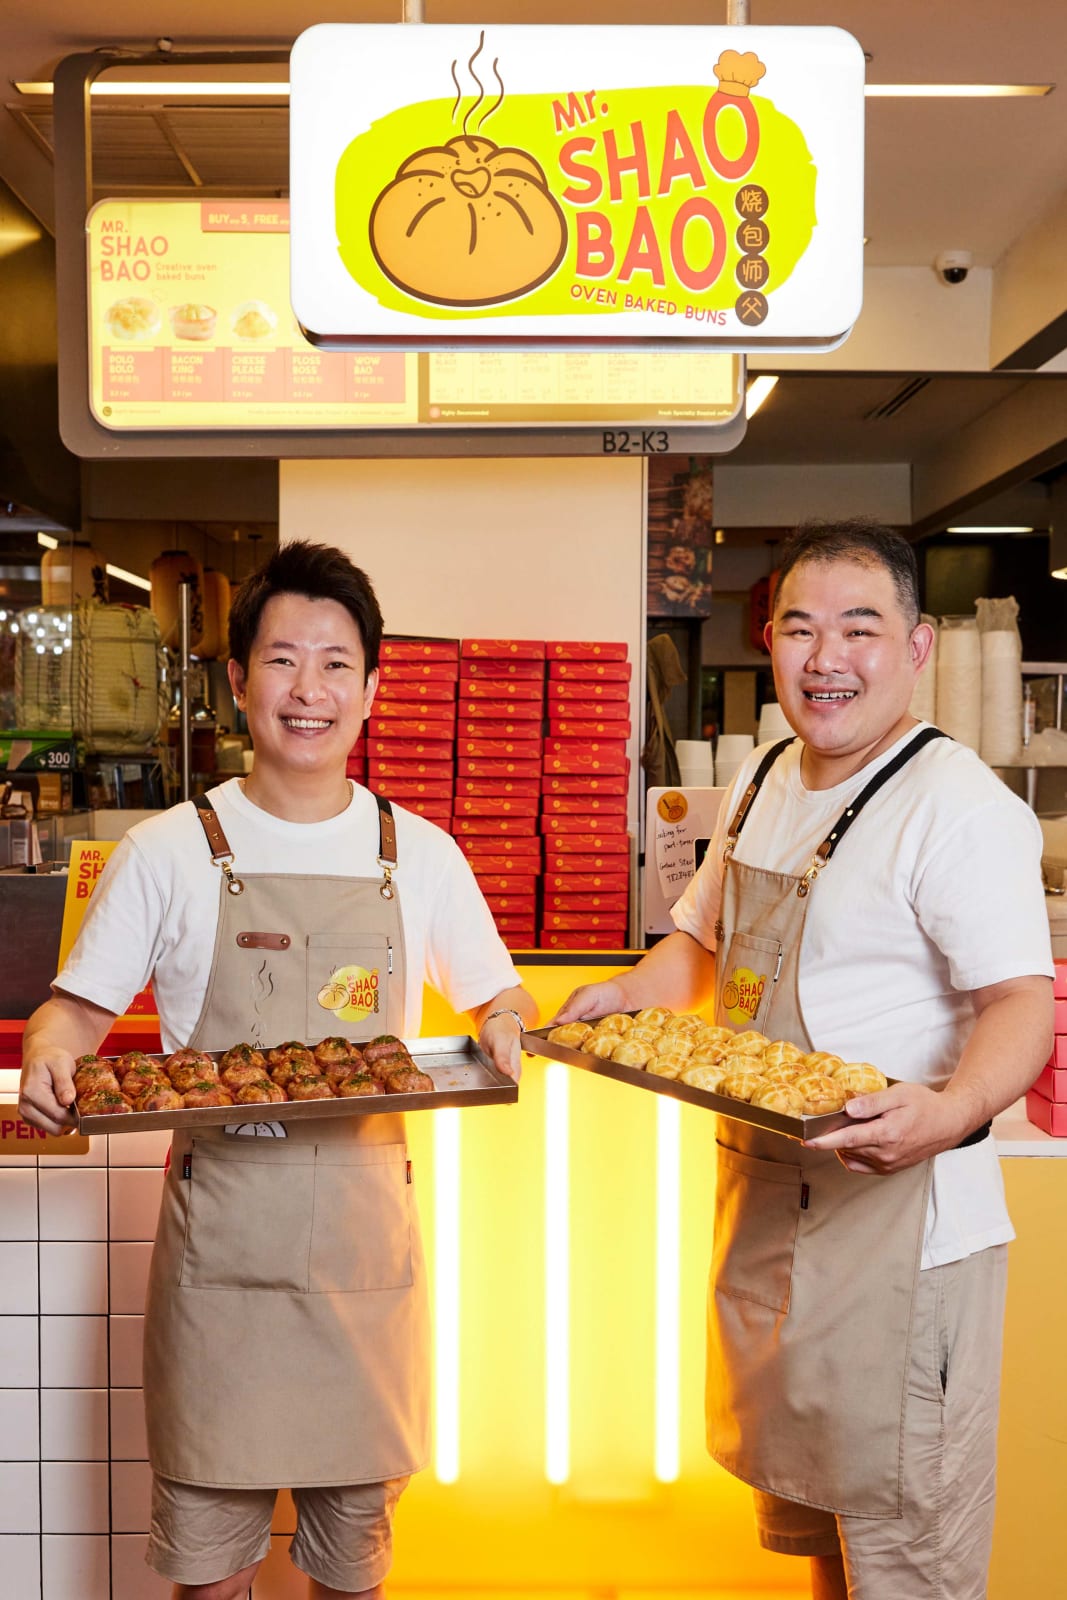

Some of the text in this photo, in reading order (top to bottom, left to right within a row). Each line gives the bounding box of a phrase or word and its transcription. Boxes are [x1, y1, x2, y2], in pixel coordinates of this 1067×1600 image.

[552, 89, 608, 133] Mr.
[558, 90, 760, 205] SHAO
[101, 220, 128, 233] MR.
[208, 213, 229, 225] BUY
[254, 213, 279, 225] FREE
[100, 236, 169, 257] SHAO
[575, 196, 727, 291] BAO
[738, 187, 767, 323] 烧包师父
[100, 260, 151, 281] BAO
[570, 284, 727, 326] OVEN BAKED BUNS
[602, 431, 670, 453] B2-K3
[48, 751, 71, 765] 300
[80, 850, 104, 861] MR.
[347, 975, 379, 994] SHAO
[739, 981, 765, 997] SHAO
[351, 991, 373, 1008] BAO
[738, 996, 757, 1014] BAO
[0, 1120, 47, 1140] PEN
